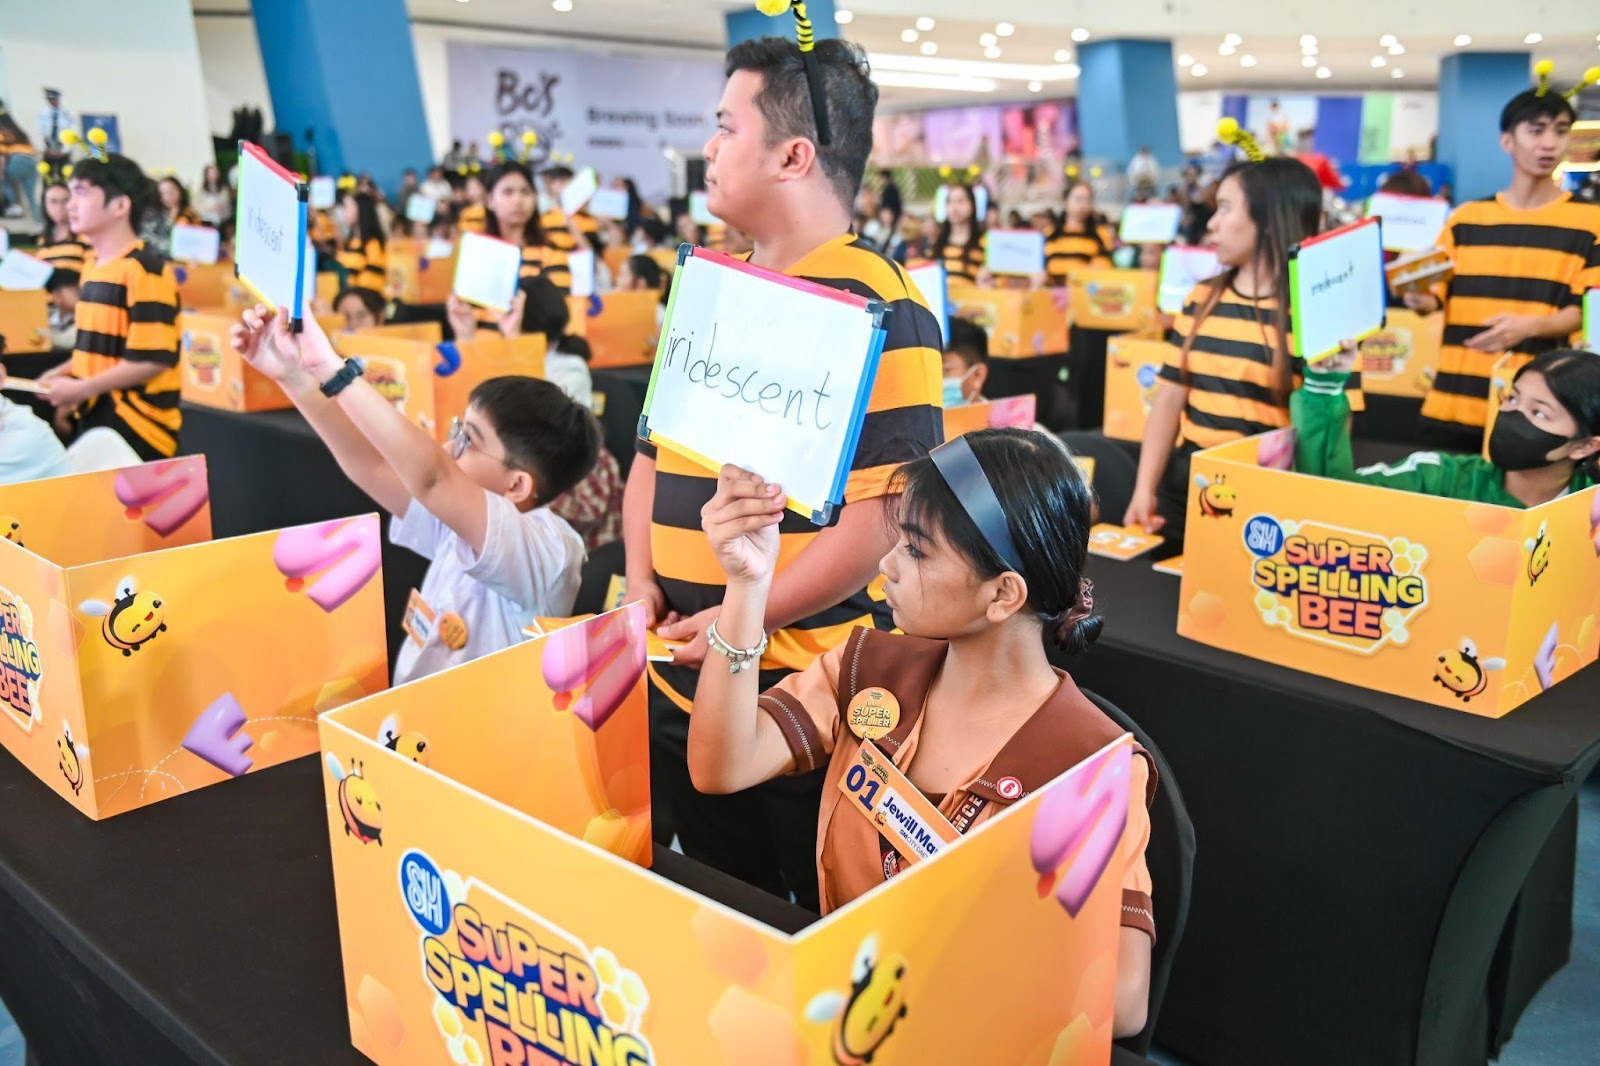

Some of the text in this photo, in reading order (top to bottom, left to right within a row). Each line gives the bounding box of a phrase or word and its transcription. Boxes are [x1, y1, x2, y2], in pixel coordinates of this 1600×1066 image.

[663, 322, 832, 430] iridescent
[1247, 519, 1279, 553] SM
[1284, 535, 1393, 573] SUPER
[1255, 559, 1424, 606] SPELLING
[0, 596, 23, 637] ER
[1299, 594, 1383, 640] BEE
[850, 716, 893, 728] SPELLER!
[853, 706, 891, 719] SUPER
[846, 764, 880, 811] 01
[883, 796, 919, 834] Jewill
[405, 860, 444, 929] SM
[453, 903, 601, 1018] SUPER
